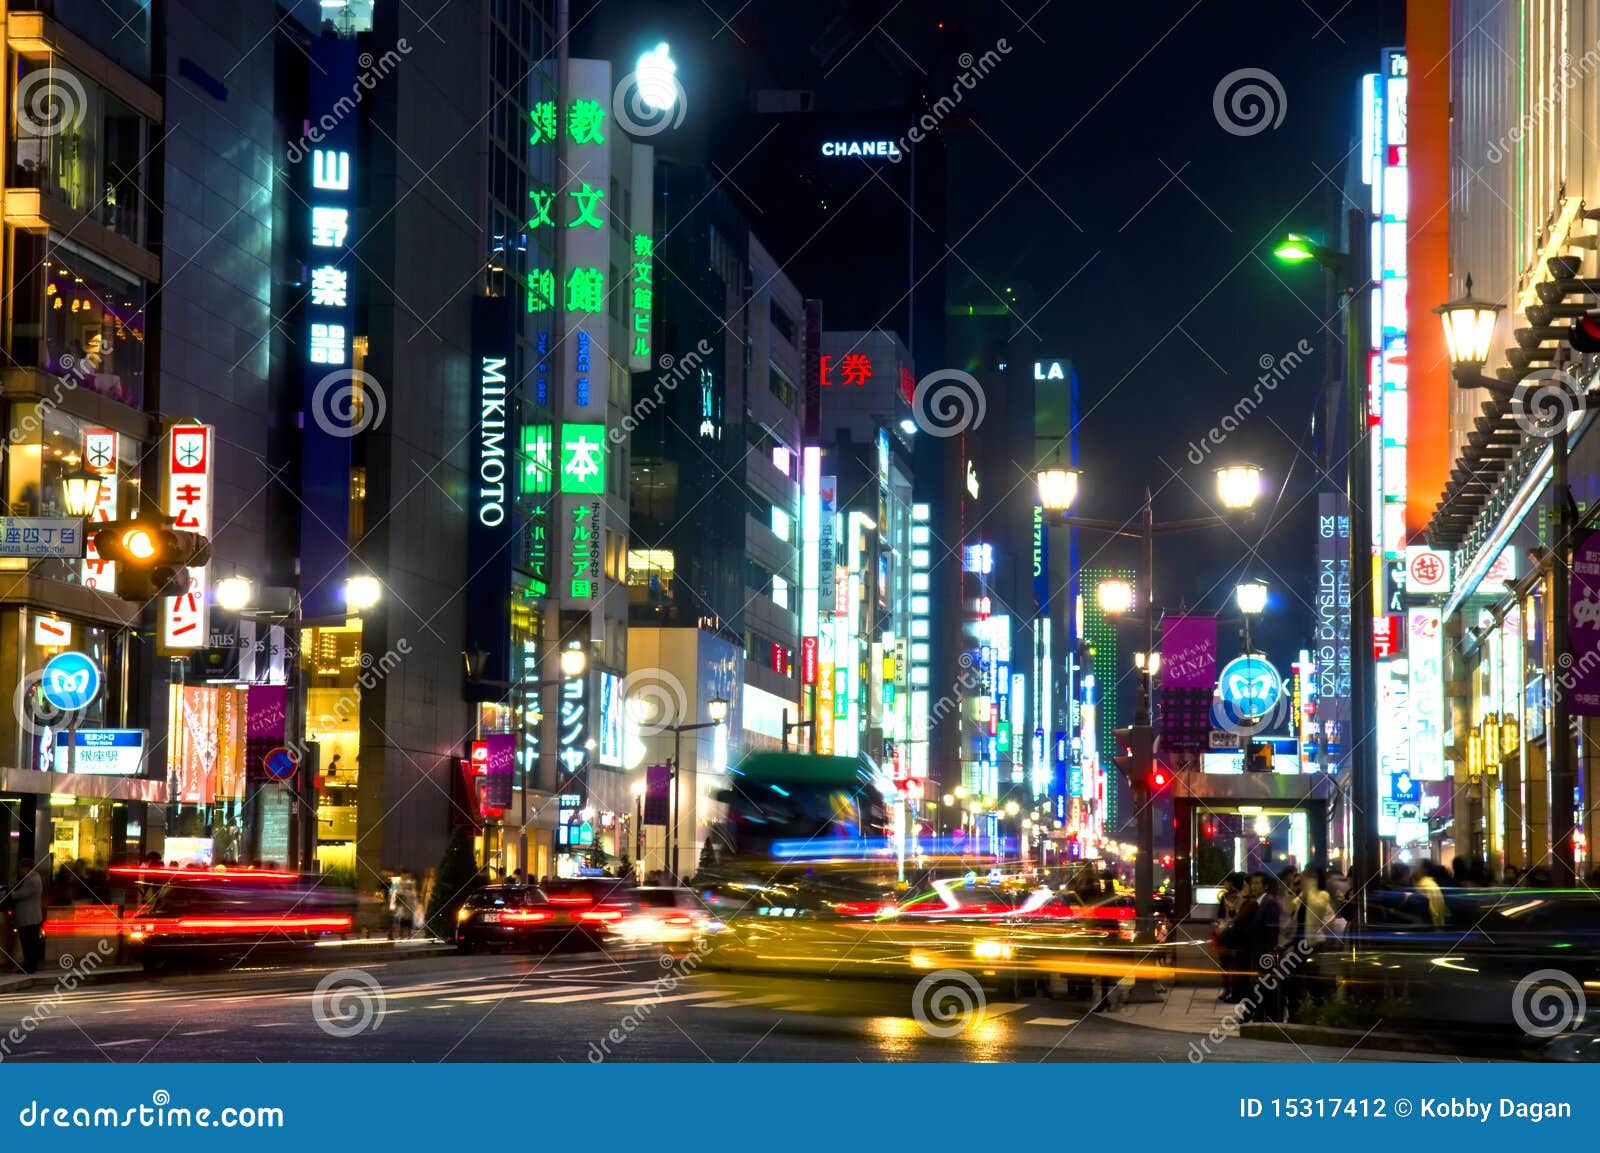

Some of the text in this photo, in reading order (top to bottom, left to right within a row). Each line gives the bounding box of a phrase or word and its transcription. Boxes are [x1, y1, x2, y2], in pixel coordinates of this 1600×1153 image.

[821, 141, 900, 156] CHANEL
[566, 98, 606, 313] 教文館
[310, 149, 349, 365] 山野楽器
[633, 233, 653, 357] 教文館ビル
[577, 331, 591, 373] SINCE
[1034, 362, 1065, 380] LA
[480, 356, 507, 527] MIKIMOTO
[564, 435, 600, 483] 本
[0, 527, 75, 544] 座四丁目
[571, 504, 591, 598] ナルニア国
[1169, 652, 1217, 680] GINZA
